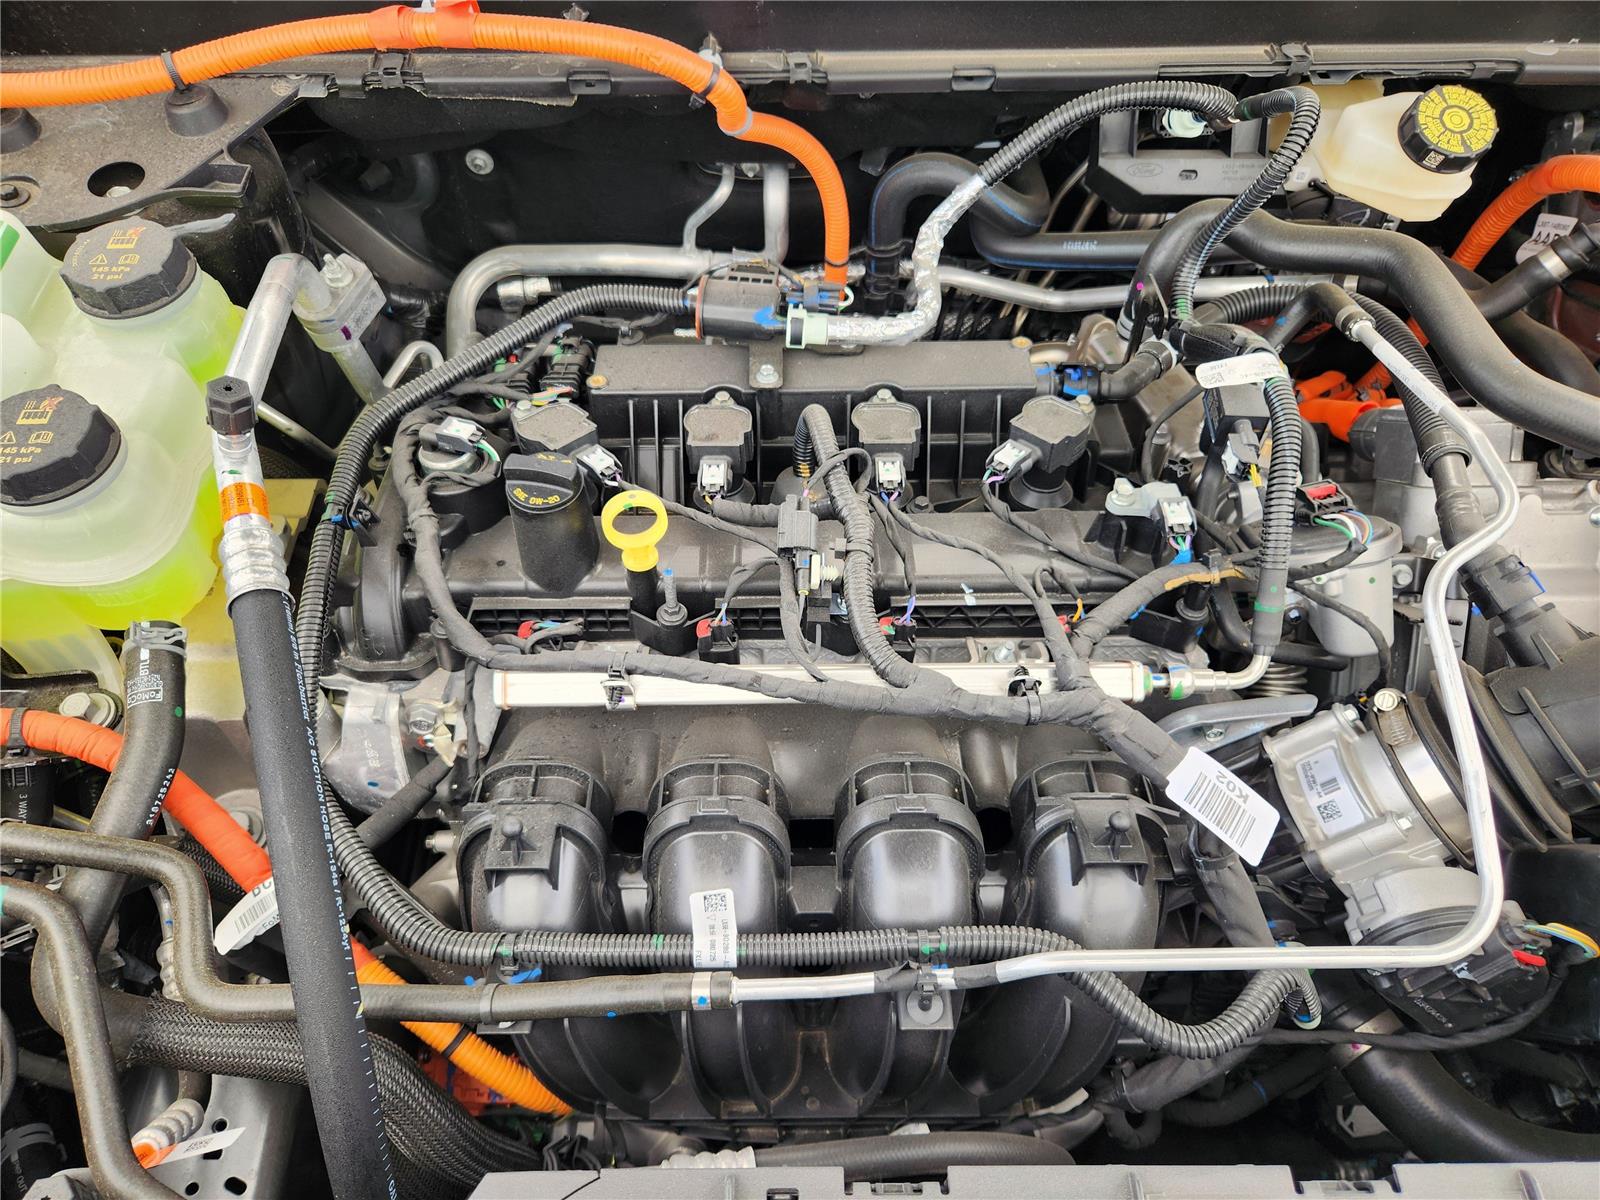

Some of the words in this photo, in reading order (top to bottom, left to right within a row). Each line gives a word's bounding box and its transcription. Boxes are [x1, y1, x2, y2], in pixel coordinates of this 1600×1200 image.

[14, 456, 33, 464] psi
[513, 487, 529, 501] SAE
[294, 661, 310, 722] Flexbarrier
[305, 726, 316, 746] A/C
[310, 748, 326, 802] SUCTION
[1216, 770, 1250, 805] K02
[18, 800, 28, 819] WAY
[319, 805, 333, 841] HOSE
[326, 843, 339, 887] R-134a
